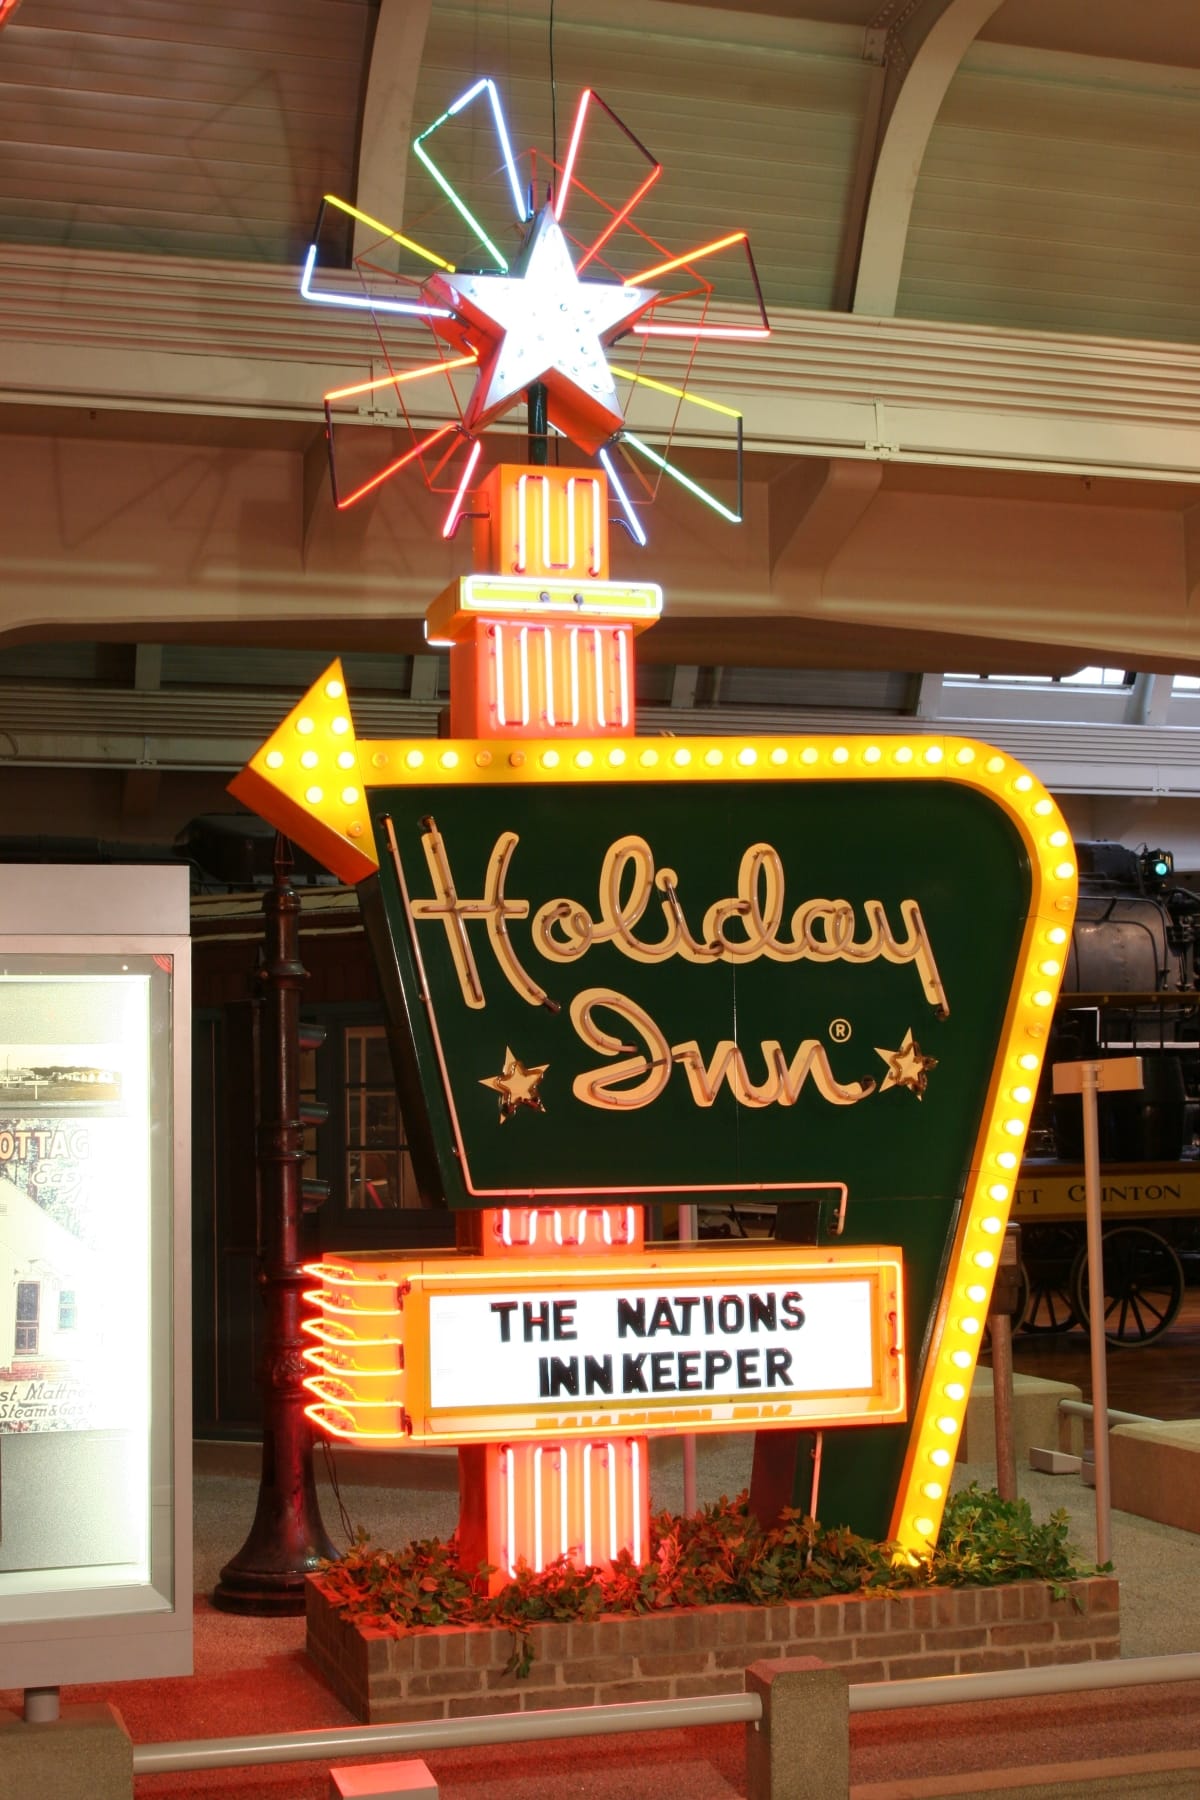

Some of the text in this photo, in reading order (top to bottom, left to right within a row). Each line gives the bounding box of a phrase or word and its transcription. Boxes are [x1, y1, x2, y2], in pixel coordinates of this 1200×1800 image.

[410, 830, 948, 1013] Holiday
[570, 988, 875, 1111] Inn
[1067, 1184, 1181, 1202] CINTON
[489, 1291, 806, 1343] THE NATIONS
[538, 1347, 794, 1398] INNKEEPER
